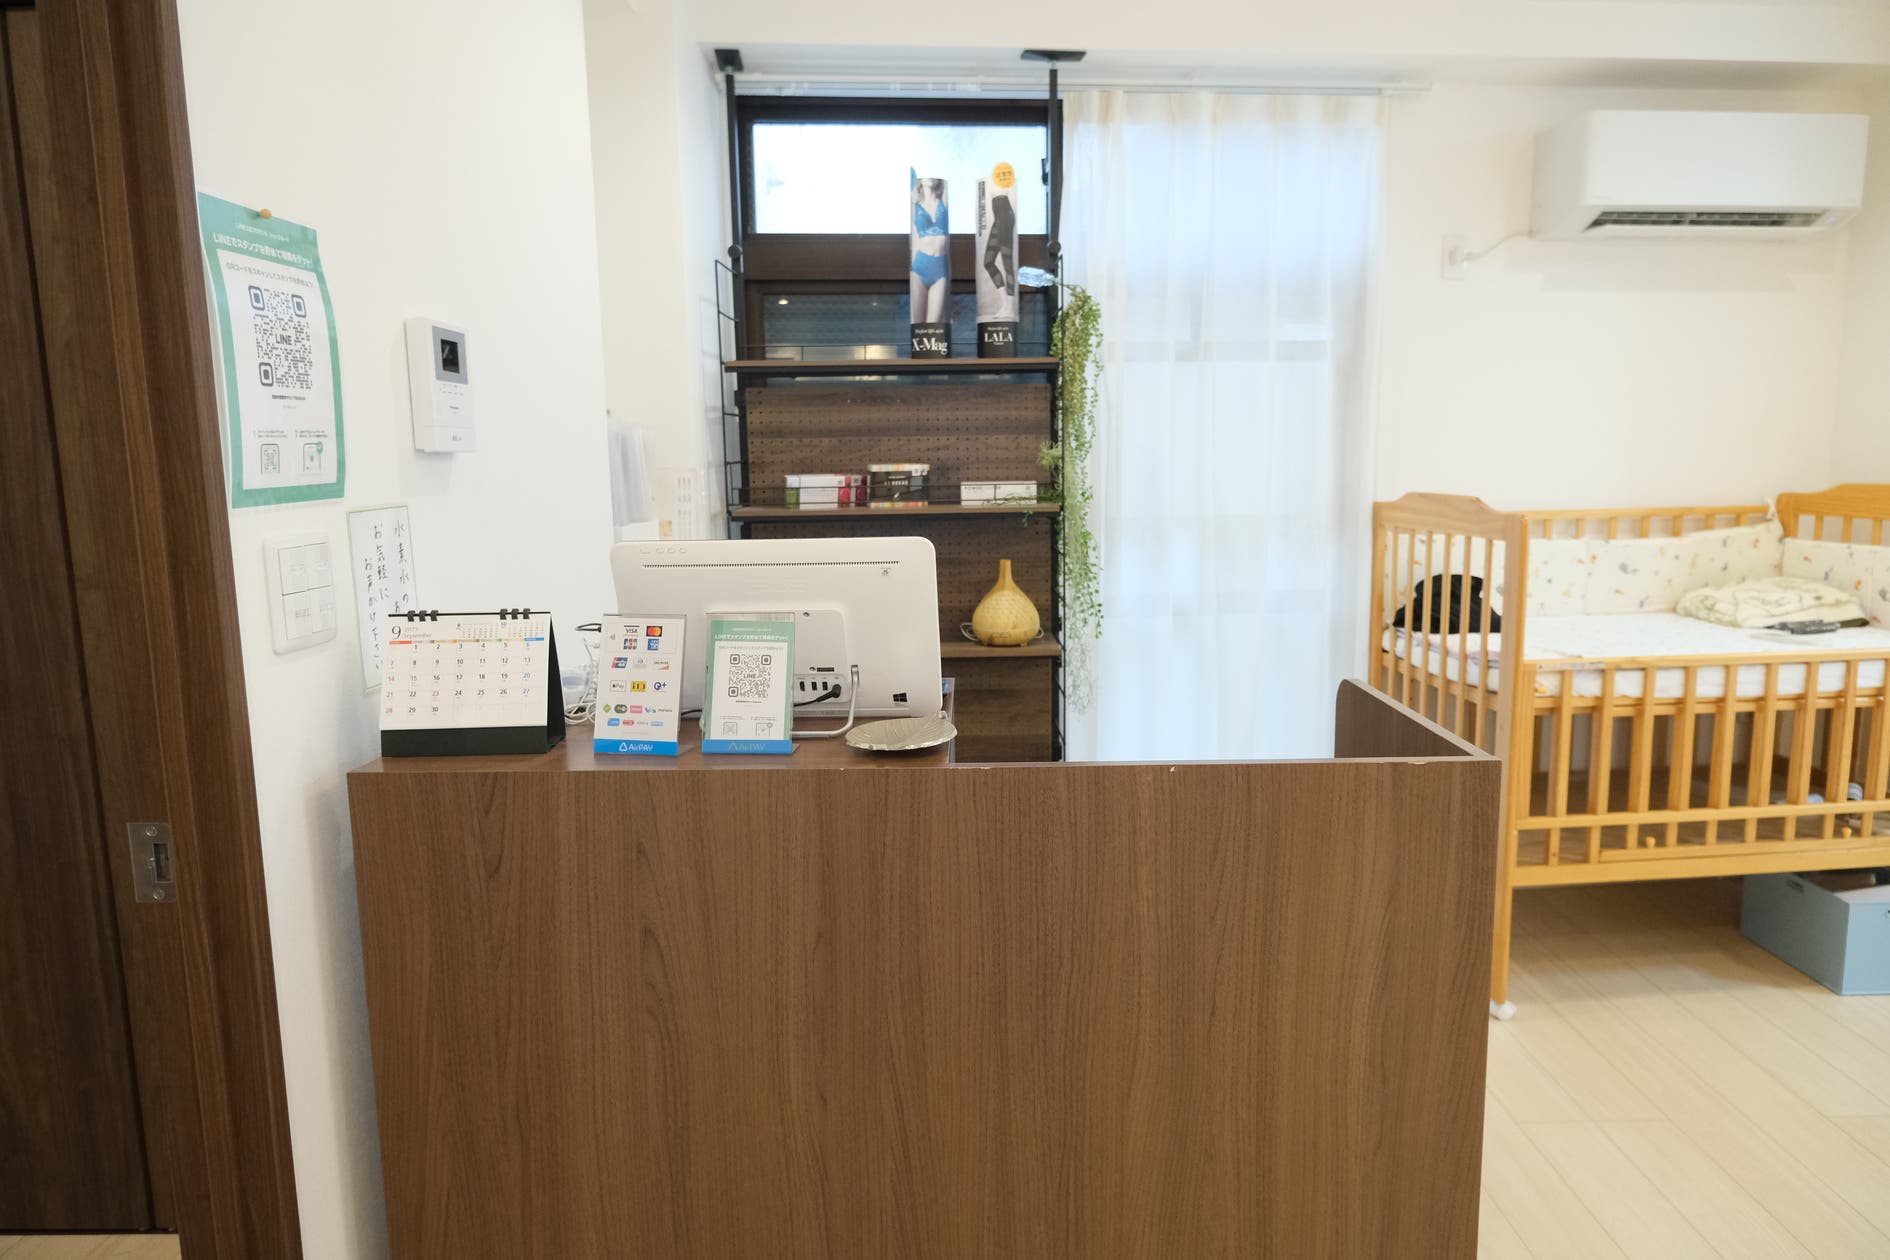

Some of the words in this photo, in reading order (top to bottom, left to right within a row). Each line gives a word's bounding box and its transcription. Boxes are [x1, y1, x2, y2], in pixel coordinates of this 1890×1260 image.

[275, 334, 293, 346] LINE
[985, 332, 1014, 343] LALA
[912, 337, 948, 356] X-Mag
[391, 625, 401, 640] 9
[628, 743, 653, 751] AirPAY
